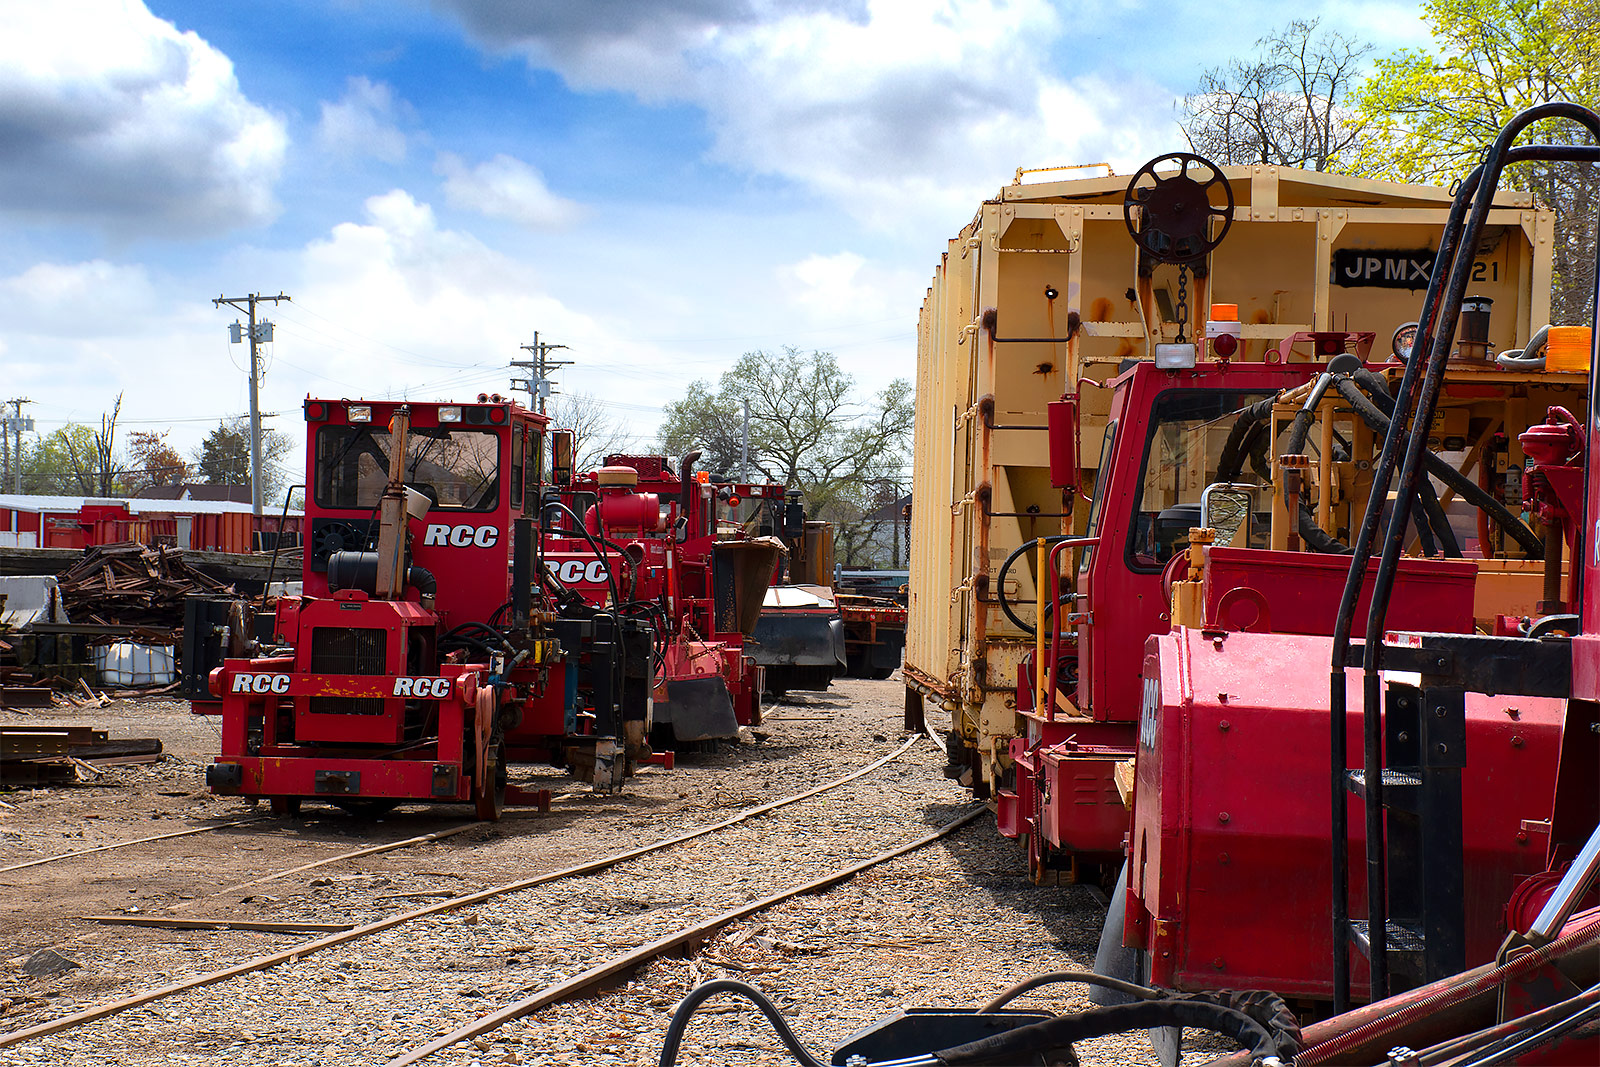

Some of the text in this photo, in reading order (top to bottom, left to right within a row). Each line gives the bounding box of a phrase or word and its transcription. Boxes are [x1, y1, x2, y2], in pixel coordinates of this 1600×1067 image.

[1345, 257, 1431, 281] JPMX
[423, 523, 499, 548] RCC
[231, 673, 291, 694] RCC
[393, 677, 451, 698] RCC
[1140, 678, 1159, 750] RCC
